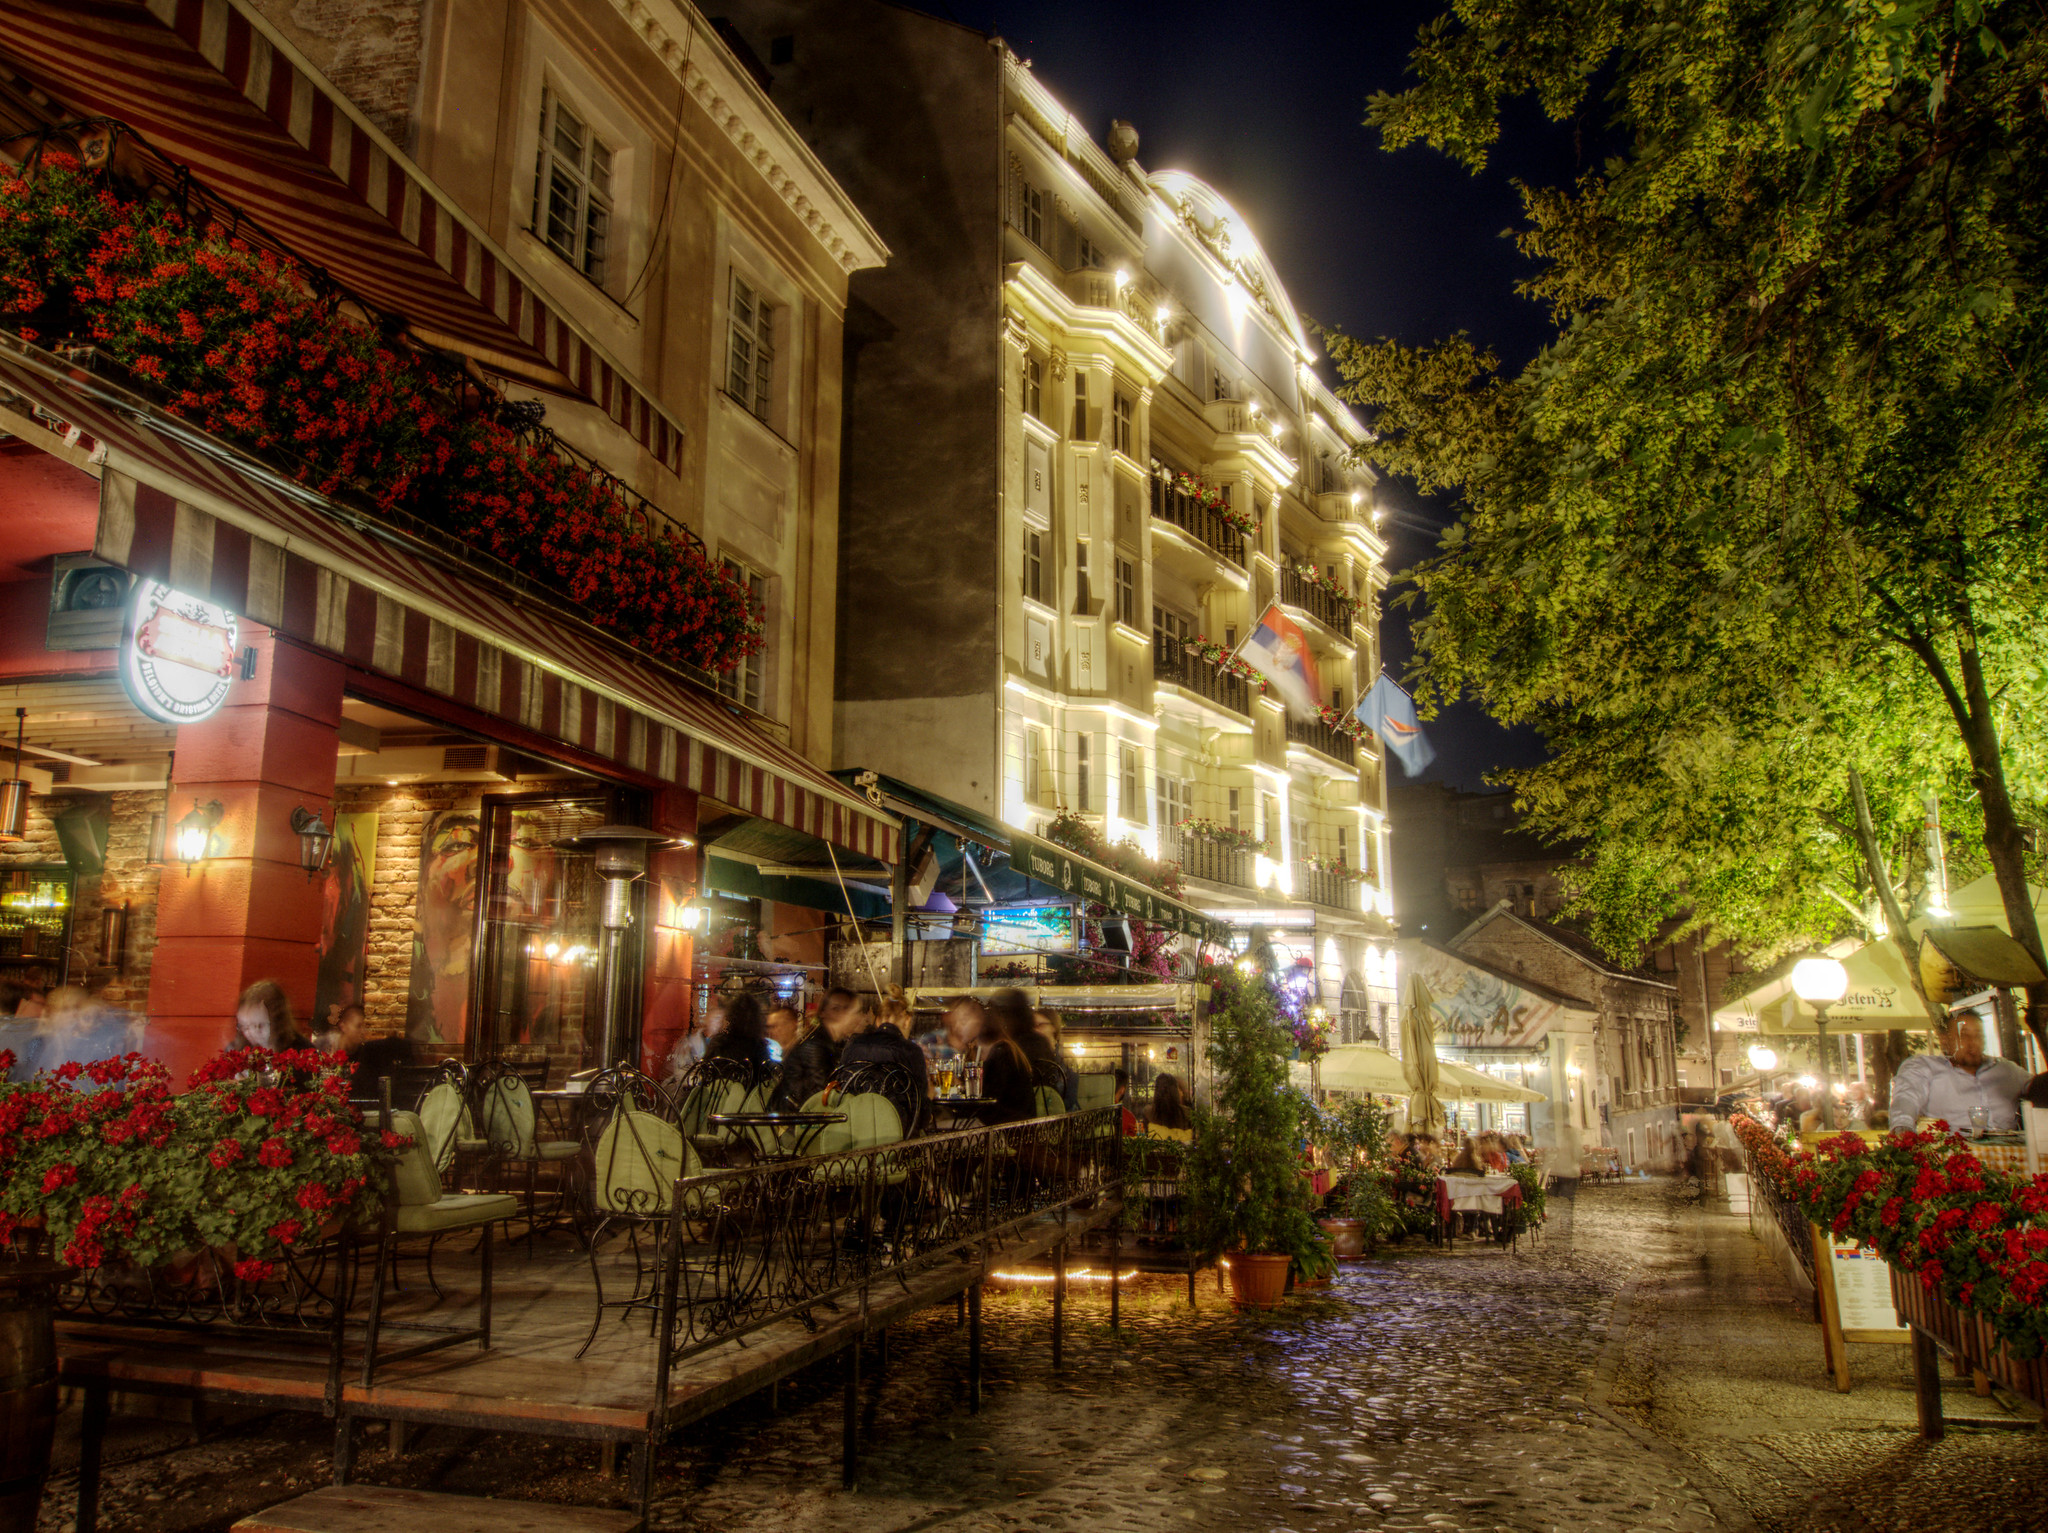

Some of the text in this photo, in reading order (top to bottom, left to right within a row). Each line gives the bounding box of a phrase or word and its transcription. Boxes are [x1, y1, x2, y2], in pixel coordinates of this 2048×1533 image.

[173, 699, 212, 716] ORIGINAL
[208, 682, 228, 705] BEER
[1030, 854, 1054, 879] TUBORG
[1083, 876, 1102, 897] TUBORG
[1125, 893, 1141, 912] TUBORG
[1836, 991, 1876, 1007] Jelen
[1490, 1000, 1528, 1037] AS
[1736, 1017, 1757, 1028] Jele
